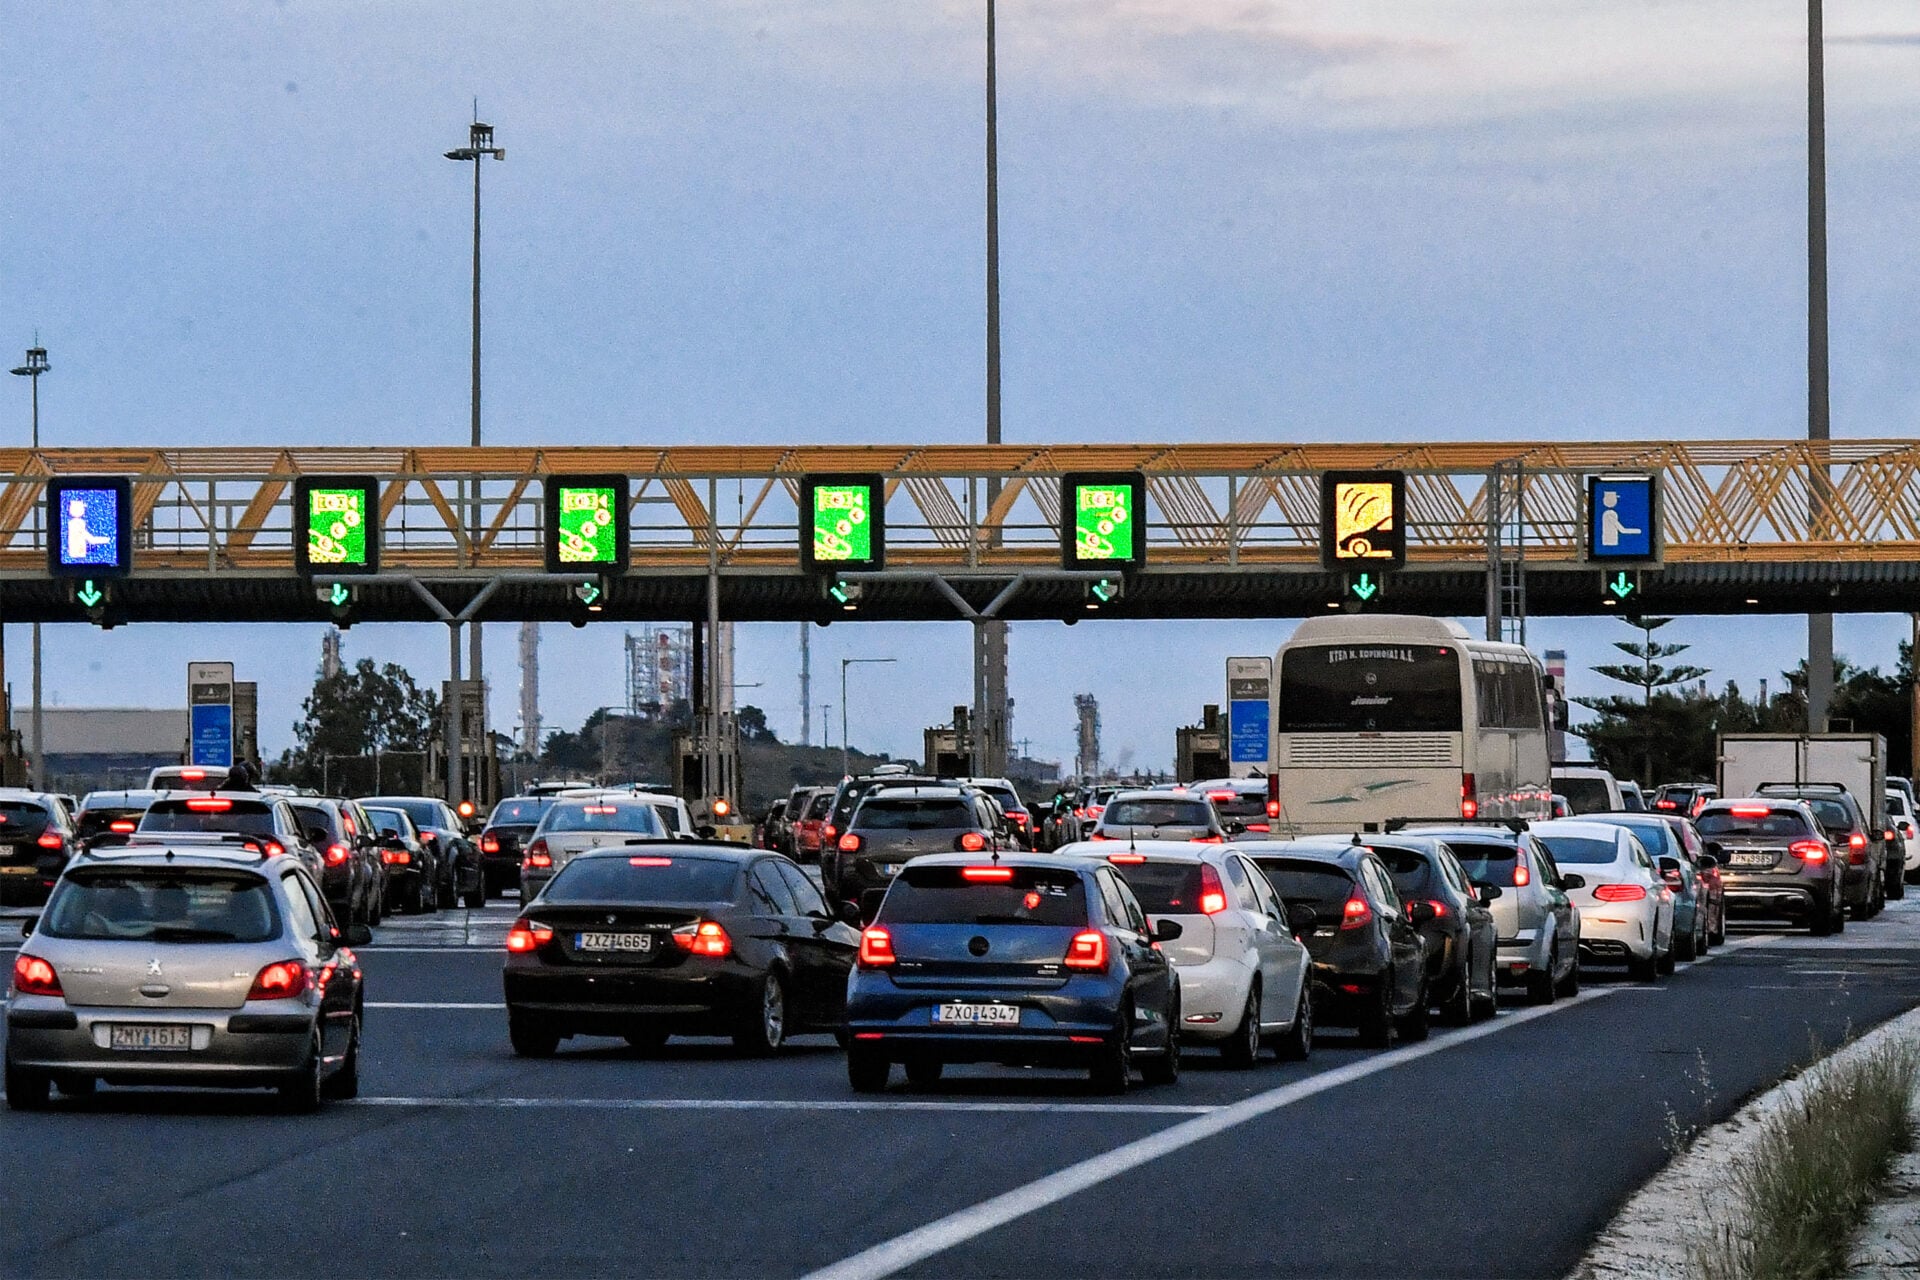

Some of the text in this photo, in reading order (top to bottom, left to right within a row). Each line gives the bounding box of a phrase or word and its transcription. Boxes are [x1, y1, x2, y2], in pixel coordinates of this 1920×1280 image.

[585, 934, 650, 949] ZXZ 4665
[944, 1006, 1017, 1021] ZXO 4347
[116, 1027, 188, 1045] ZMY 1613
